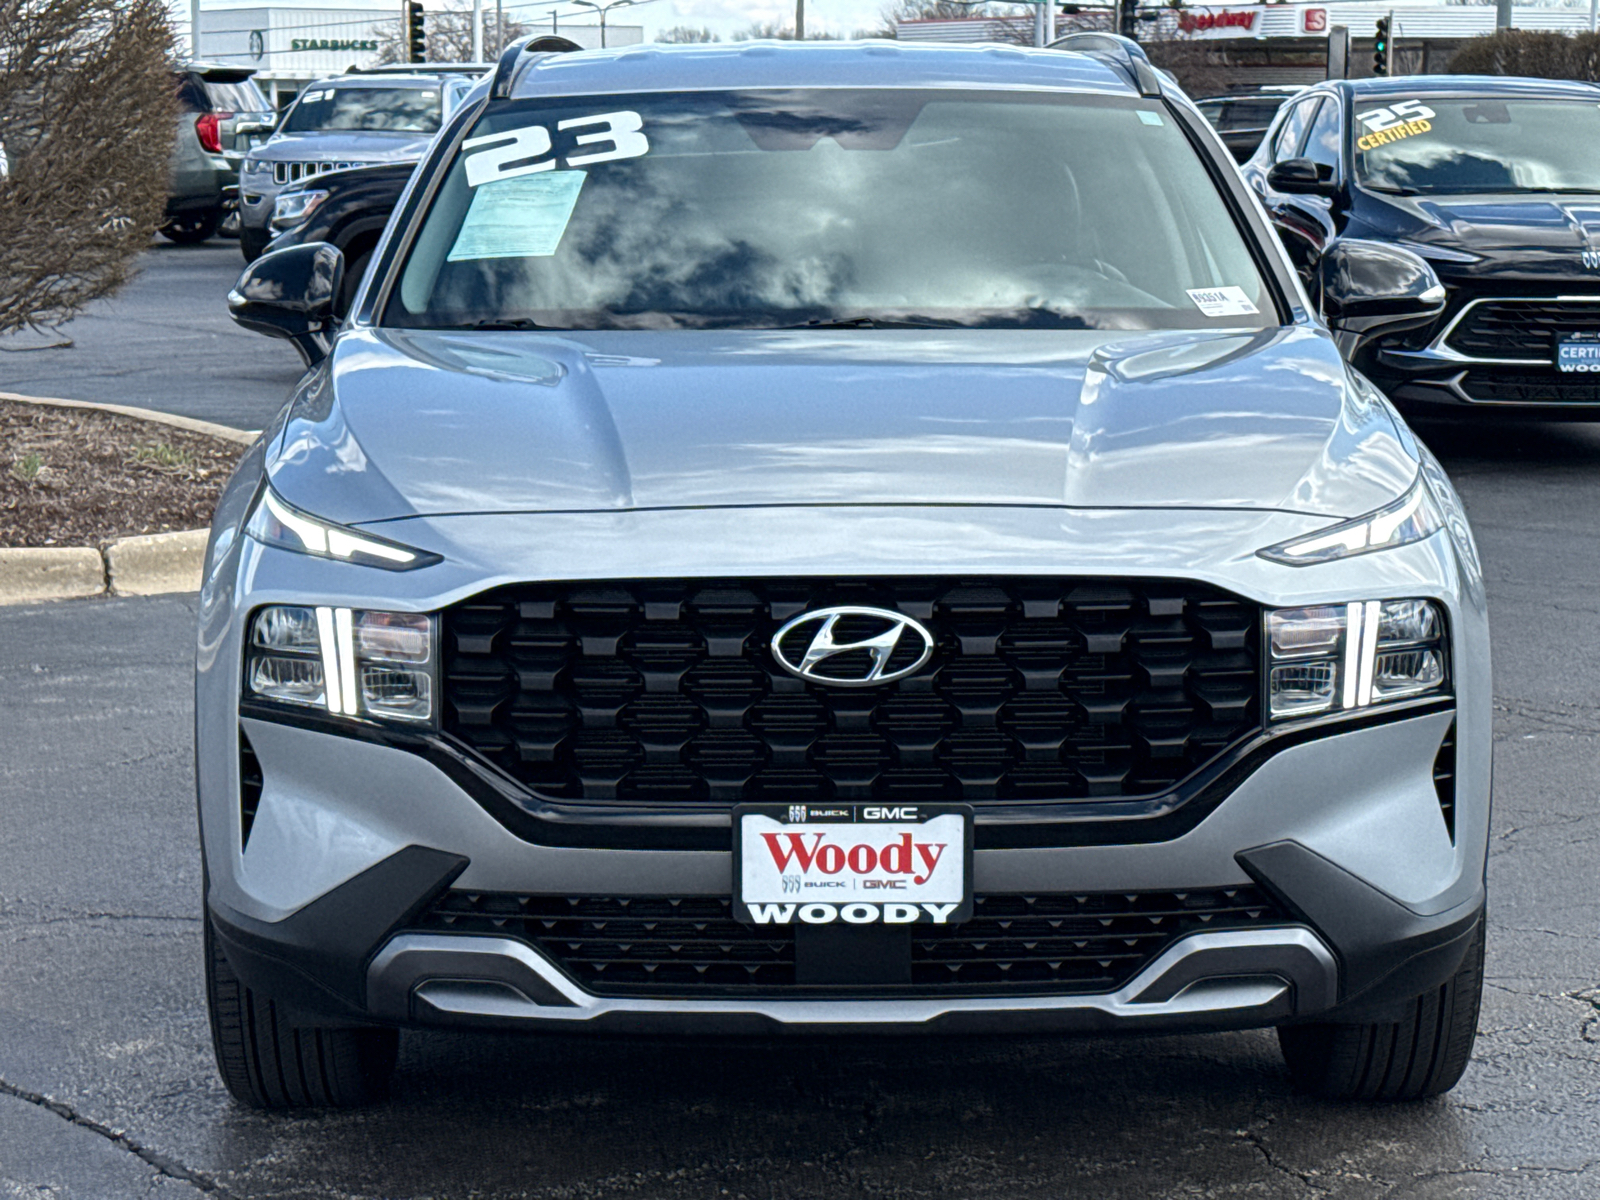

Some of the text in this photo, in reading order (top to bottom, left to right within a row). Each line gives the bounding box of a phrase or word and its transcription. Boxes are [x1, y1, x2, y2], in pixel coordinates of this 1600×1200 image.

[1178, 8, 1257, 34] Speedway
[291, 39, 378, 51] STARBUCKS
[302, 88, 335, 104] 21
[1356, 99, 1436, 132] 25
[1357, 119, 1432, 151] CERTIFIED
[462, 110, 649, 187] 23
[1560, 347, 1600, 358] CERTI
[863, 807, 918, 820] GMC
[759, 832, 948, 885] Woody
[863, 879, 907, 890] GMC
[747, 903, 959, 924] WOODY
